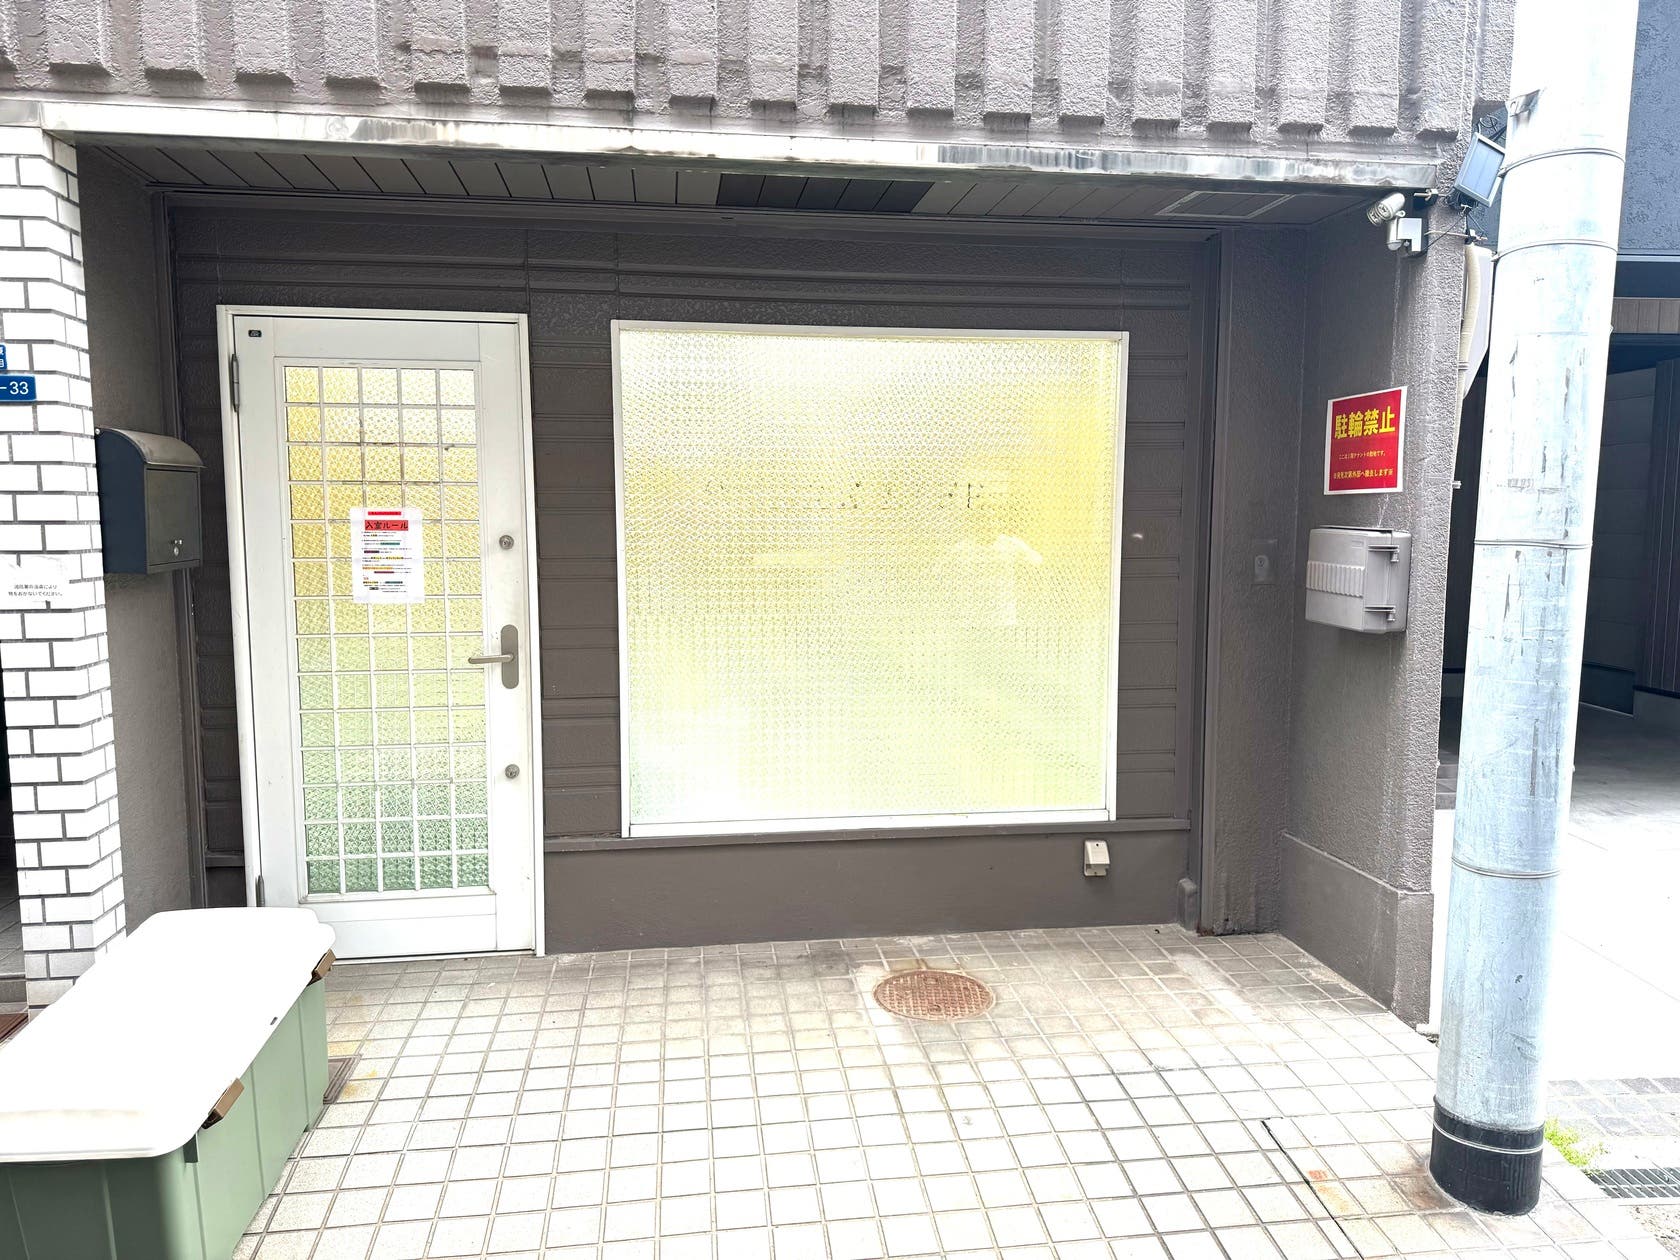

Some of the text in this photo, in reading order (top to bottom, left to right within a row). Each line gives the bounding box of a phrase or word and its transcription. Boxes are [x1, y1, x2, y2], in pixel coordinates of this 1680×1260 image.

[1335, 406, 1395, 439] 駐輪禁止
[366, 521, 408, 530] 入室ルール
